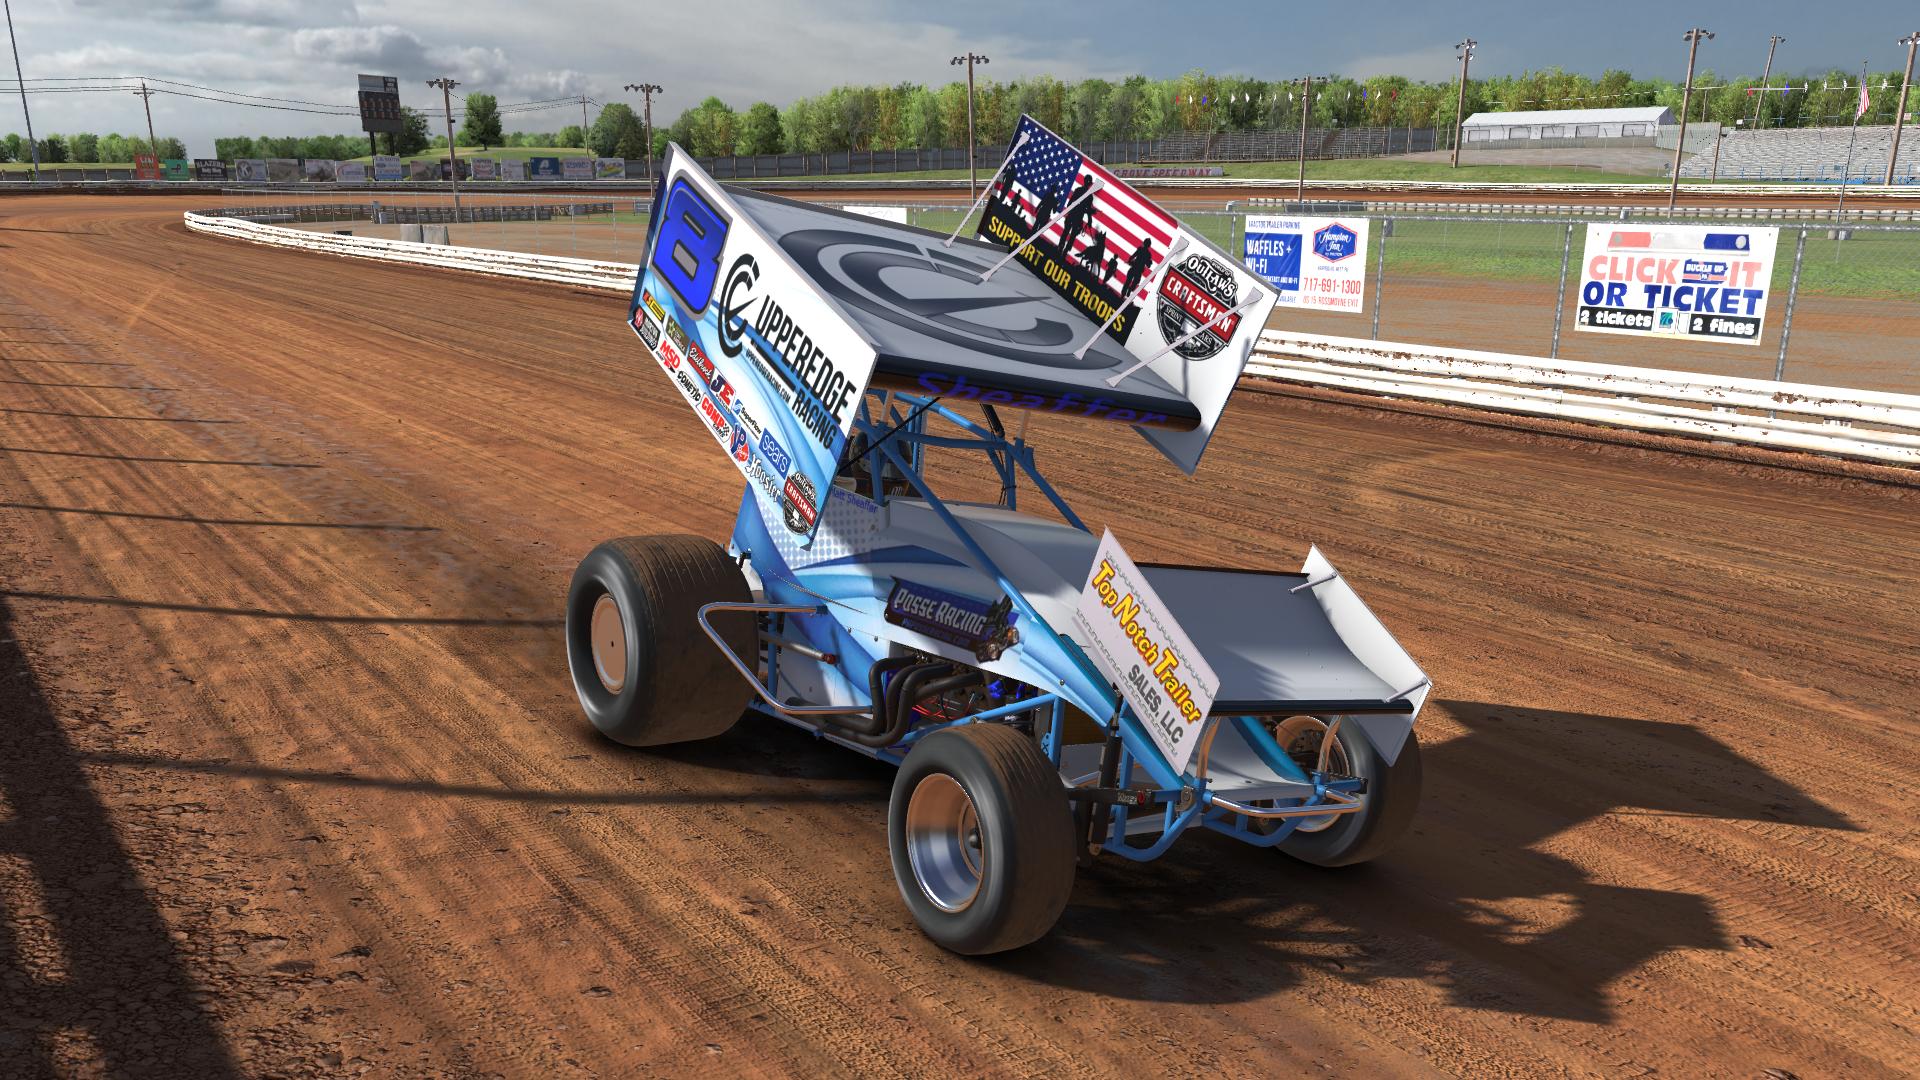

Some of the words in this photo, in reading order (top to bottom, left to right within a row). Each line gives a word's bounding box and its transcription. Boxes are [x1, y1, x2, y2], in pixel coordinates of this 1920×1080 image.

[1114, 169, 1150, 177] GROVE
[1152, 168, 1211, 177] SPEEDWAY
[651, 174, 731, 317] 8
[1246, 239, 1284, 256] WAFFLES
[1319, 231, 1351, 244] Hampton
[1326, 241, 1343, 251] Inn
[988, 216, 1044, 267] SUPPORT
[1043, 259, 1072, 290] OUR
[1073, 280, 1126, 333] TROOPS
[1245, 257, 1268, 274] WI-FI
[1588, 255, 1680, 285] CLICK
[1728, 261, 1762, 287] IT
[1686, 263, 1712, 272] BUCKLE
[1714, 264, 1724, 272] UP
[1303, 277, 1361, 294] 717-691-1300
[1583, 281, 1627, 306] OR
[1643, 284, 1764, 316] TICKET
[1166, 306, 1183, 321] SPRINT
[1200, 331, 1213, 344] ARS
[1579, 310, 1590, 323] 2
[1595, 309, 1652, 328] tickets
[1692, 318, 1703, 332] 2
[1709, 318, 1755, 337] fines
[660, 340, 681, 369] MSD
[755, 294, 857, 425] UPPEREDGE
[710, 374, 735, 406] JE
[917, 371, 1168, 425] Sheaffer
[701, 397, 725, 428] COMP
[792, 388, 839, 450] RACING
[762, 434, 788, 473] sears
[745, 453, 781, 502] Hoosier
[786, 482, 815, 521] CRAFTSMAN
[894, 588, 937, 620] POSSE
[935, 601, 988, 636] RACING
[1091, 560, 1119, 608] Top
[1112, 592, 1159, 667] Notch
[1152, 648, 1202, 725] Trailer
[1128, 663, 1160, 719] SALES,
[1159, 710, 1184, 744] LLC
